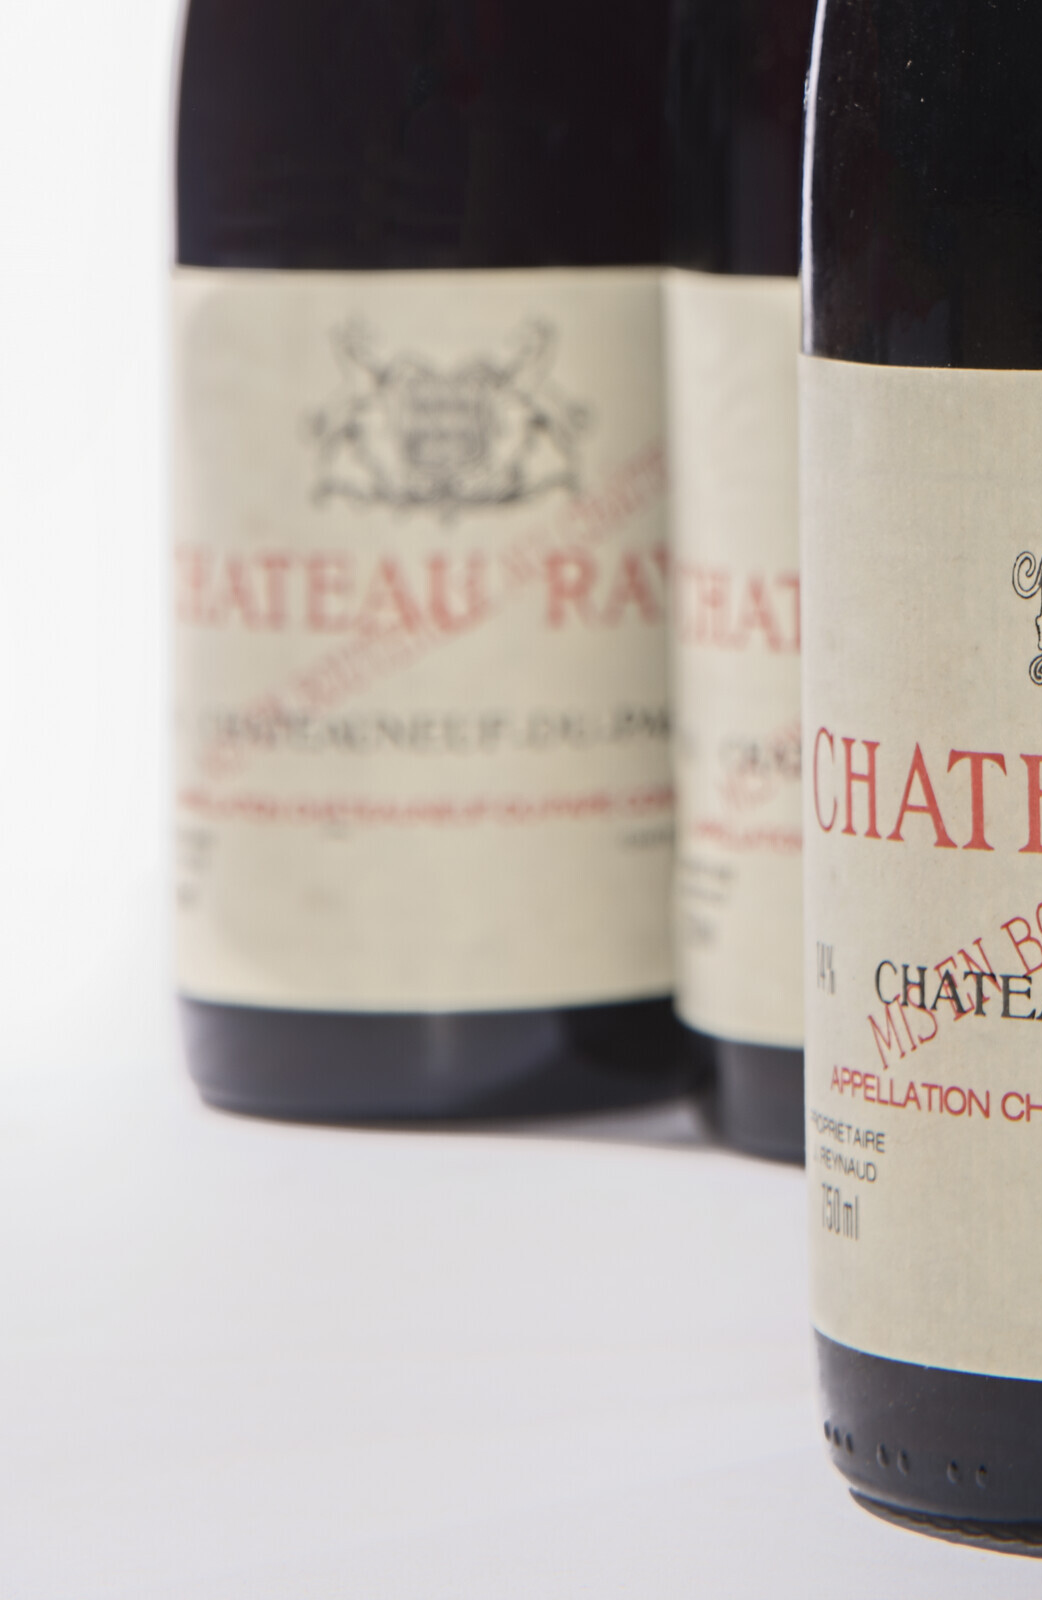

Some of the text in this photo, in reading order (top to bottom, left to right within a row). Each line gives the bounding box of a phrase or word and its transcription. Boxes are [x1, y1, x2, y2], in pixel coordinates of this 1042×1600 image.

[867, 982, 938, 1071] MIS
[933, 937, 1002, 1022] EN
[830, 1064, 991, 1120] APPELLATION
